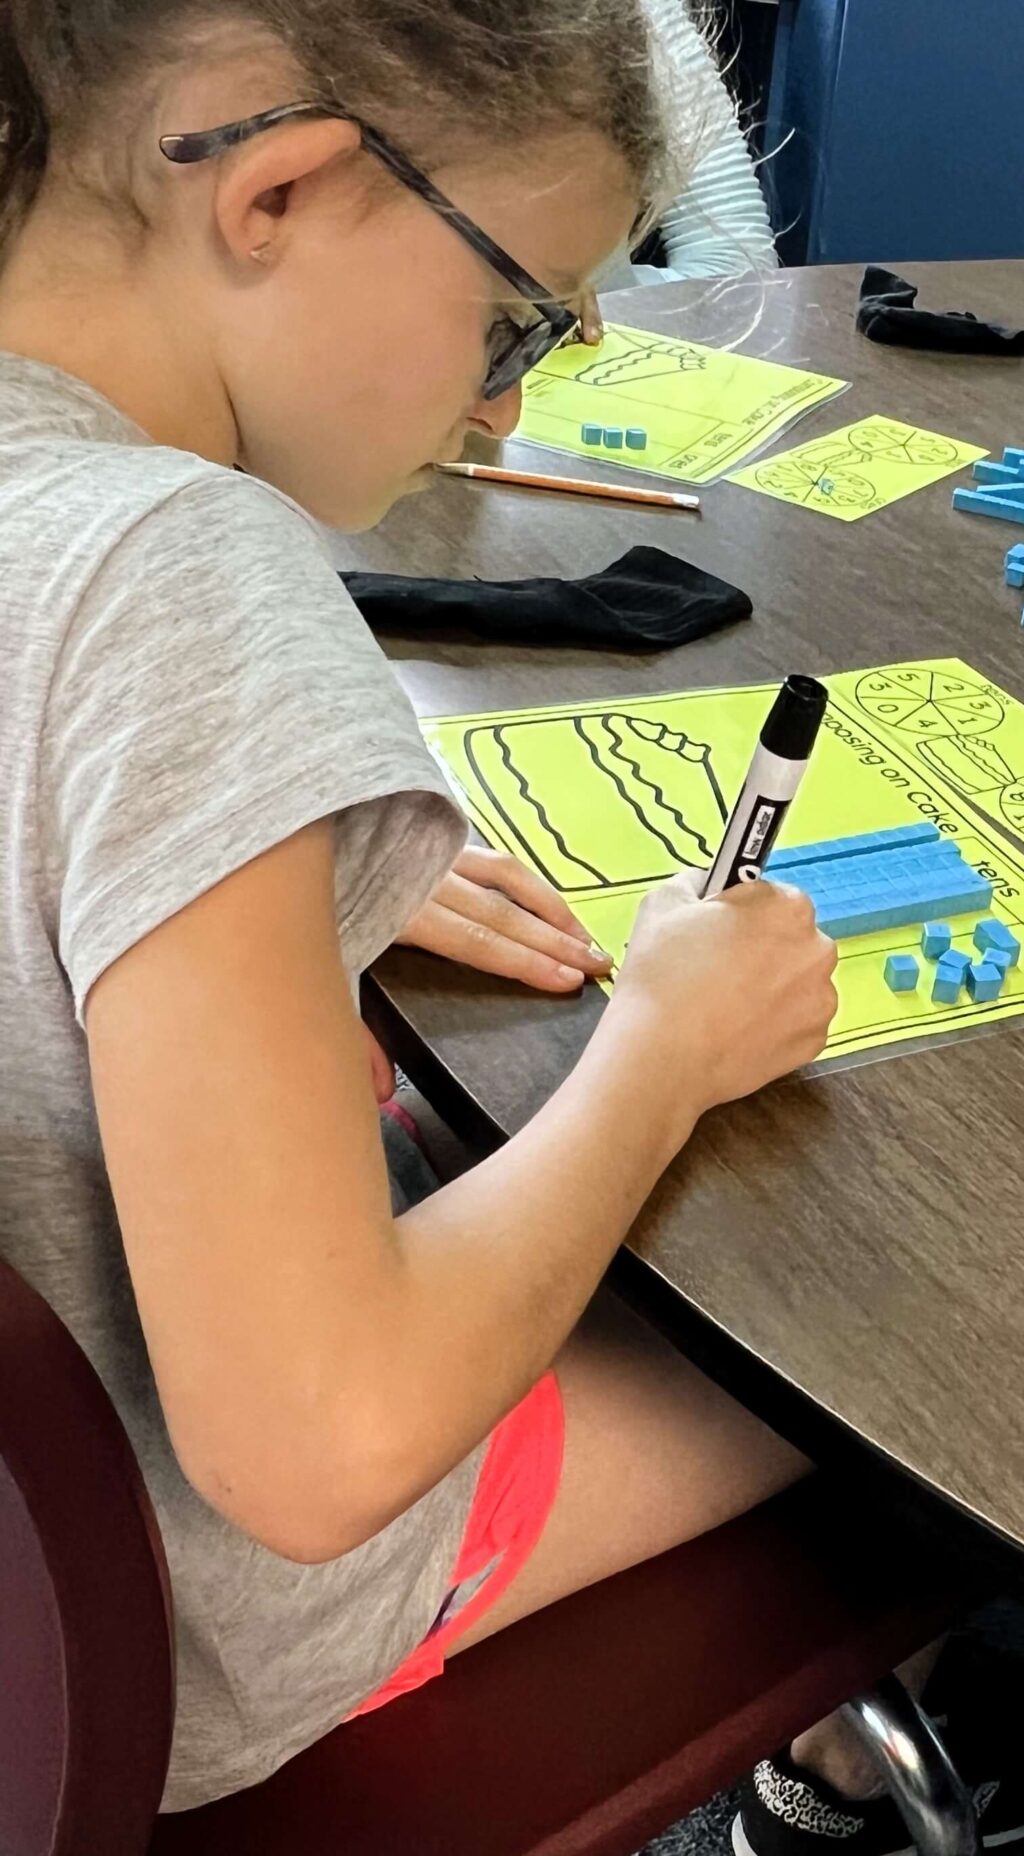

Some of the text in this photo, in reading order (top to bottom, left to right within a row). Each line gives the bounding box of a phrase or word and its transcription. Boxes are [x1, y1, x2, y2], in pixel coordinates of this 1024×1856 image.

[897, 672, 921, 682] 5
[869, 682, 893, 692] 3
[943, 683, 965, 693] 2
[877, 703, 899, 714] 0
[969, 700, 992, 711] 3
[918, 719, 938, 729] 4
[957, 717, 978, 725] 1
[821, 711, 959, 835] posing on Cake
[972, 860, 1020, 899] tens
